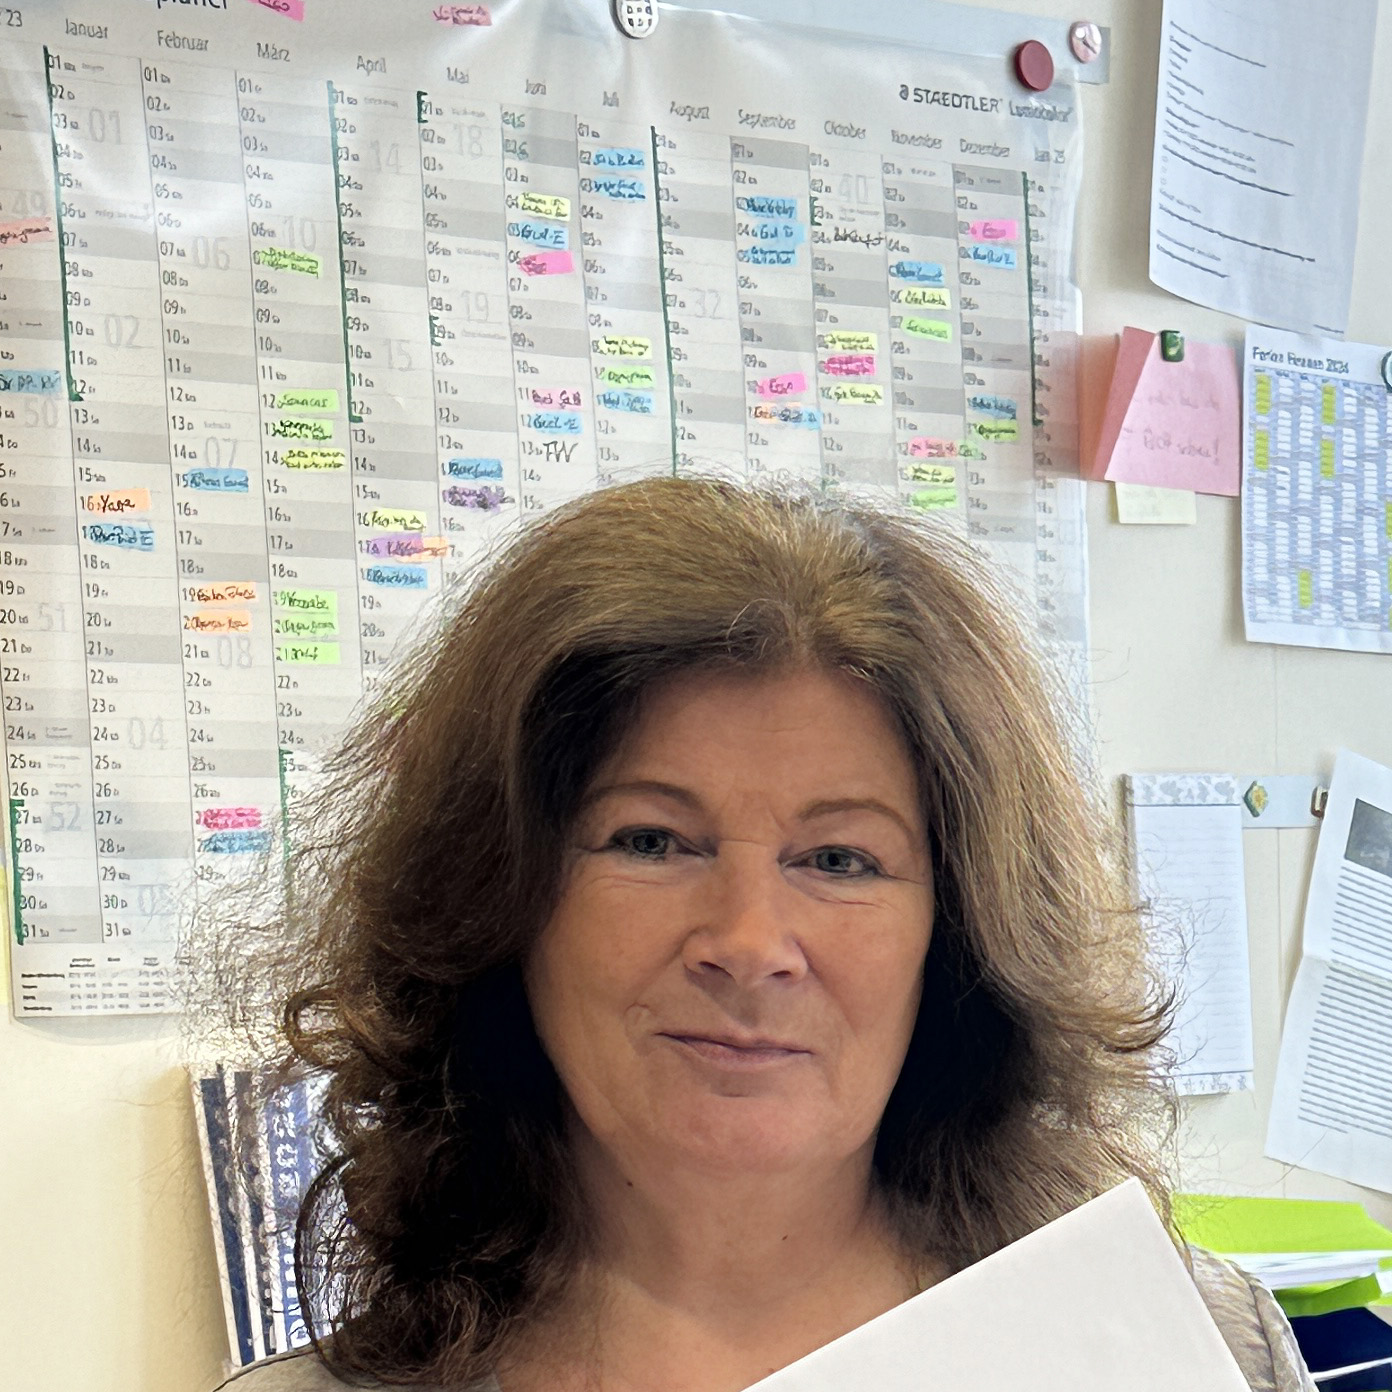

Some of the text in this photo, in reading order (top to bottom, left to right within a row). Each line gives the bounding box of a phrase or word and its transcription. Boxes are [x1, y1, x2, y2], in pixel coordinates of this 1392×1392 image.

[157, 30, 209, 51] Februar
[356, 56, 387, 76] April
[913, 87, 1000, 114] STAEDTLER
